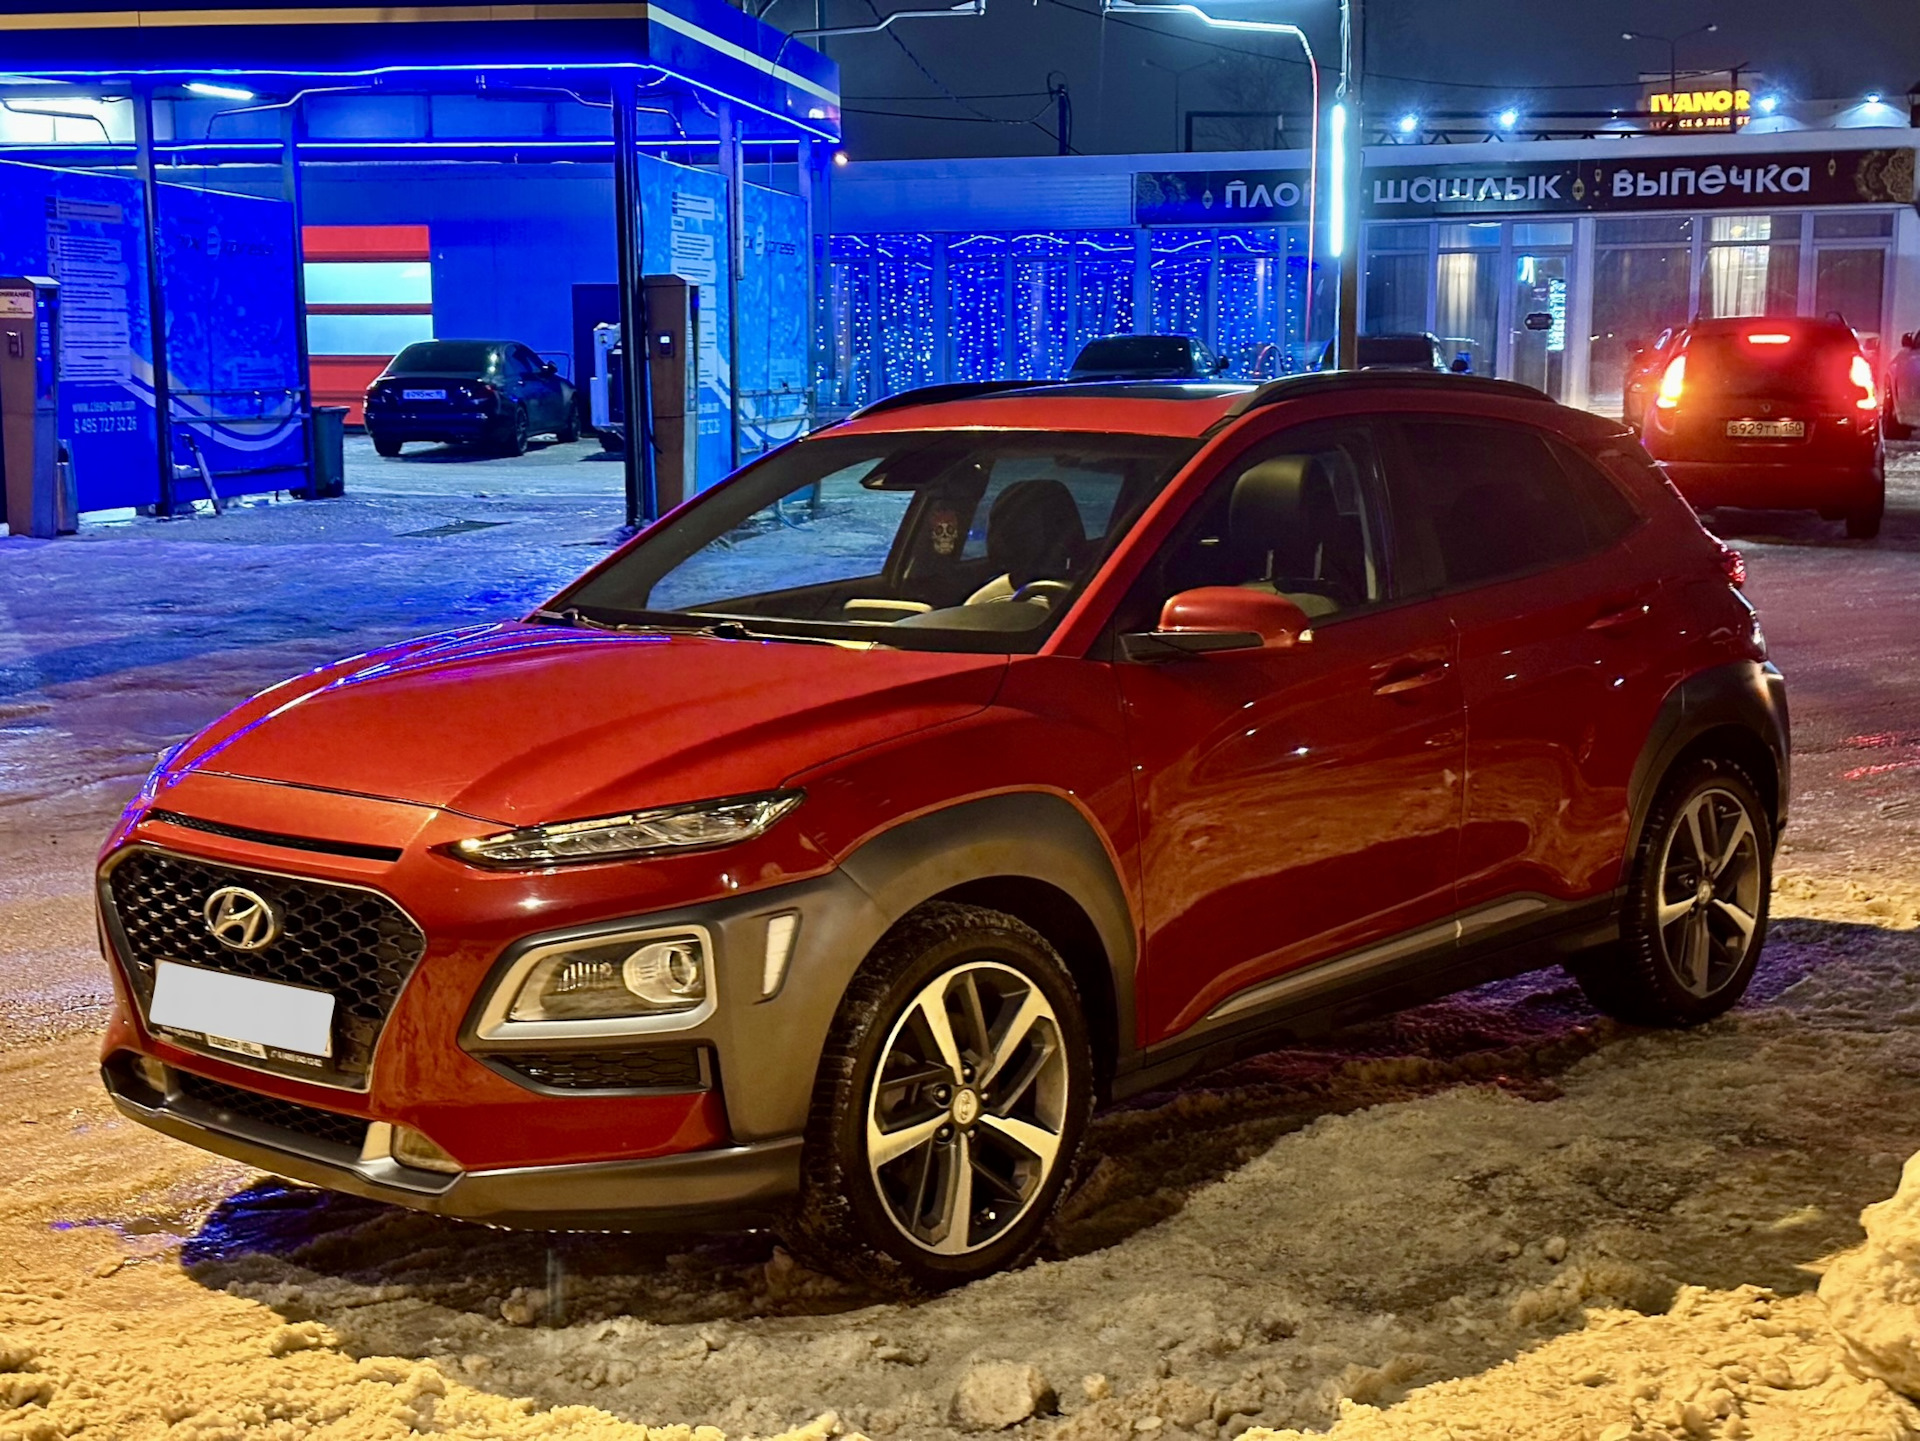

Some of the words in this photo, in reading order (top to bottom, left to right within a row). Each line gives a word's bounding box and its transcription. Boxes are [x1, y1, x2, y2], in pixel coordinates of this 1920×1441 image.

[1650, 89, 1751, 113] IVANOR
[1706, 115, 1751, 127] MARET
[1373, 174, 1562, 204] шашлык
[1612, 164, 1811, 198] выпечка
